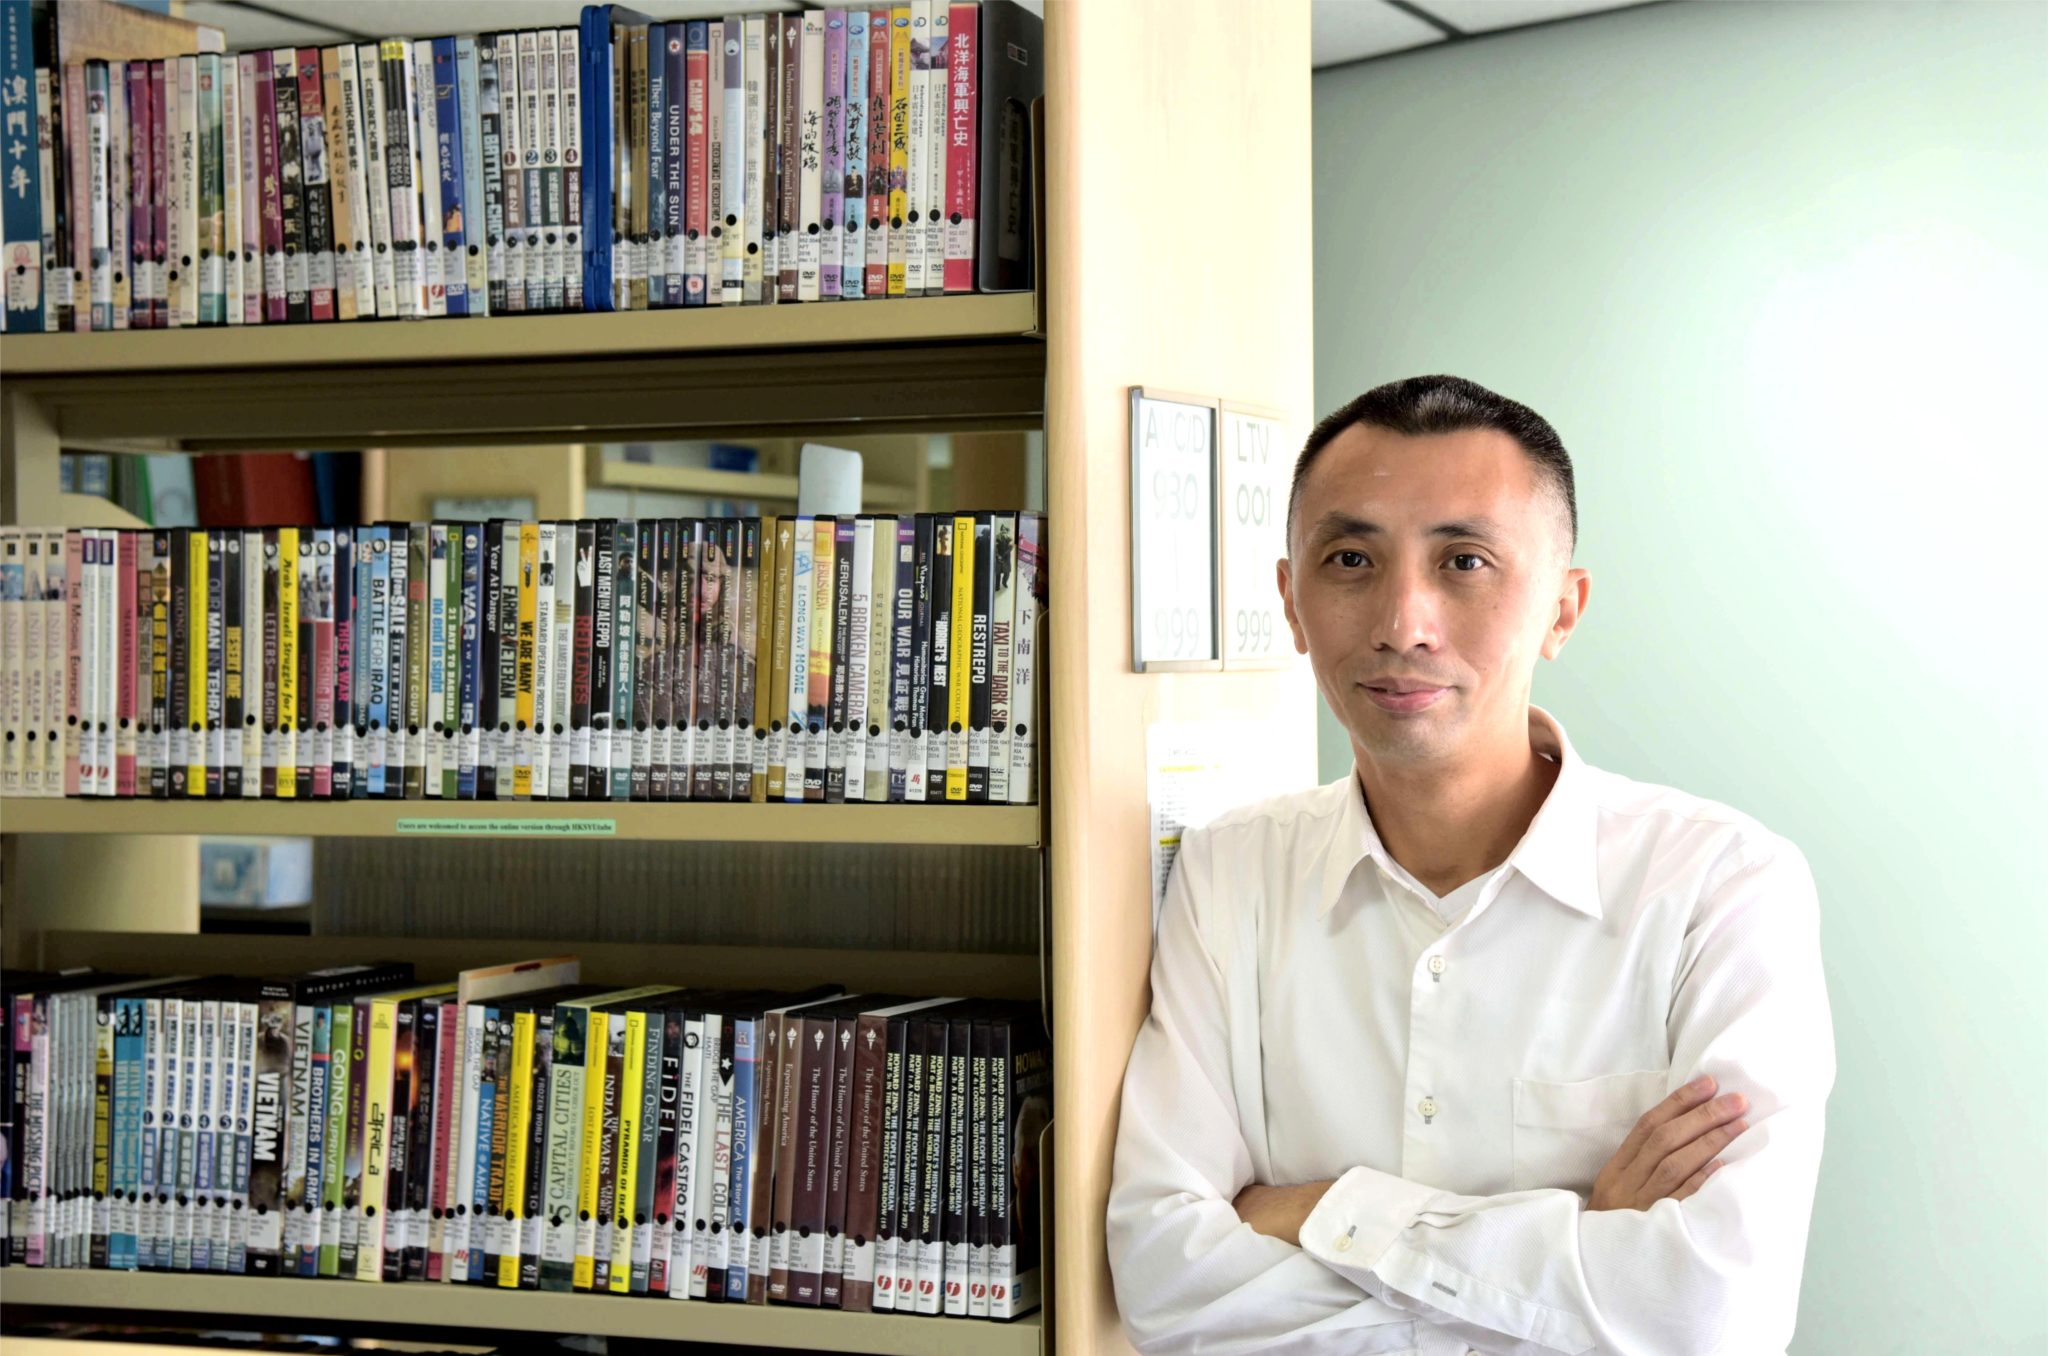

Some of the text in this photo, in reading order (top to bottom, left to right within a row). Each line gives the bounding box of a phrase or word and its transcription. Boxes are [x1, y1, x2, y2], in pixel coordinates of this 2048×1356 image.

[650, 77, 662, 179] Tibet: Beyond Fear
[689, 113, 703, 136] 14
[690, 79, 703, 112] CAMP
[784, 63, 795, 119] Understanding
[953, 34, 970, 146] 北洋海軍興亡史
[2, 75, 31, 198] 澳門十年
[482, 134, 501, 191] BATTLE
[670, 105, 680, 226] UNDER THE SUN
[783, 121, 794, 147] Japan:
[712, 142, 720, 221] NORTH KOREA
[783, 191, 792, 221] History
[784, 158, 793, 190] Cultural
[1236, 420, 1269, 464] LTV
[1152, 469, 1198, 520] 930
[1236, 484, 1271, 526] 001
[463, 585, 477, 641] WAR
[487, 545, 501, 632] Year At Danger
[837, 558, 850, 625] JERUSALEM
[896, 588, 913, 658] OUR WAR
[69, 582, 80, 708] THE MOGHUL EMPERORS
[226, 626, 241, 699] DESERT ONE
[264, 612, 276, 665] LETTERS
[337, 620, 350, 703] THIS IS WAR
[370, 579, 386, 705] BATTLE FOR IRAQ
[430, 598, 444, 694] no end in sight
[519, 622, 532, 694] WE ARE MANY
[536, 601, 549, 686] STANDARD OPERATING
[574, 615, 592, 704] RED LINES
[677, 649, 686, 679] Episodes
[793, 593, 806, 694] LONG WAY HOME
[934, 611, 948, 687] THE HORNET'S NEST
[972, 614, 986, 684] RESTREPO
[991, 621, 1010, 705] TAXI TO THE DARK
[1017, 609, 1031, 685] 下南洋
[1154, 607, 1200, 658] 999
[1237, 610, 1272, 652] 999
[555, 628, 567, 716] THE JAMES FOLEY STORY
[291, 1021, 310, 1116] VIETNAM
[642, 1027, 660, 1142] FINDING OSCAR
[781, 1063, 794, 1146] Experiencing America
[991, 1077, 997, 1085] 2:
[30, 1092, 44, 1163] THE MISSING
[254, 1072, 280, 1161] VIETNAM
[308, 1067, 325, 1163] BROTHERS IN
[326, 1049, 346, 1184] GOING UPRIVER
[478, 1099, 491, 1151] NATIVE
[492, 1076, 508, 1153] THE WARRIOR
[509, 1083, 521, 1167] AMERICA BEFORE
[550, 1069, 572, 1200] CAPITAL CITIES
[600, 1074, 615, 1175] INDIAN WARS
[676, 1072, 694, 1206] THE FIDEL CASTRO
[715, 1092, 732, 1175] THE LAST
[832, 1067, 847, 1191] The History of the United States
[620, 1120, 631, 1191] PYRAMIDS OF
